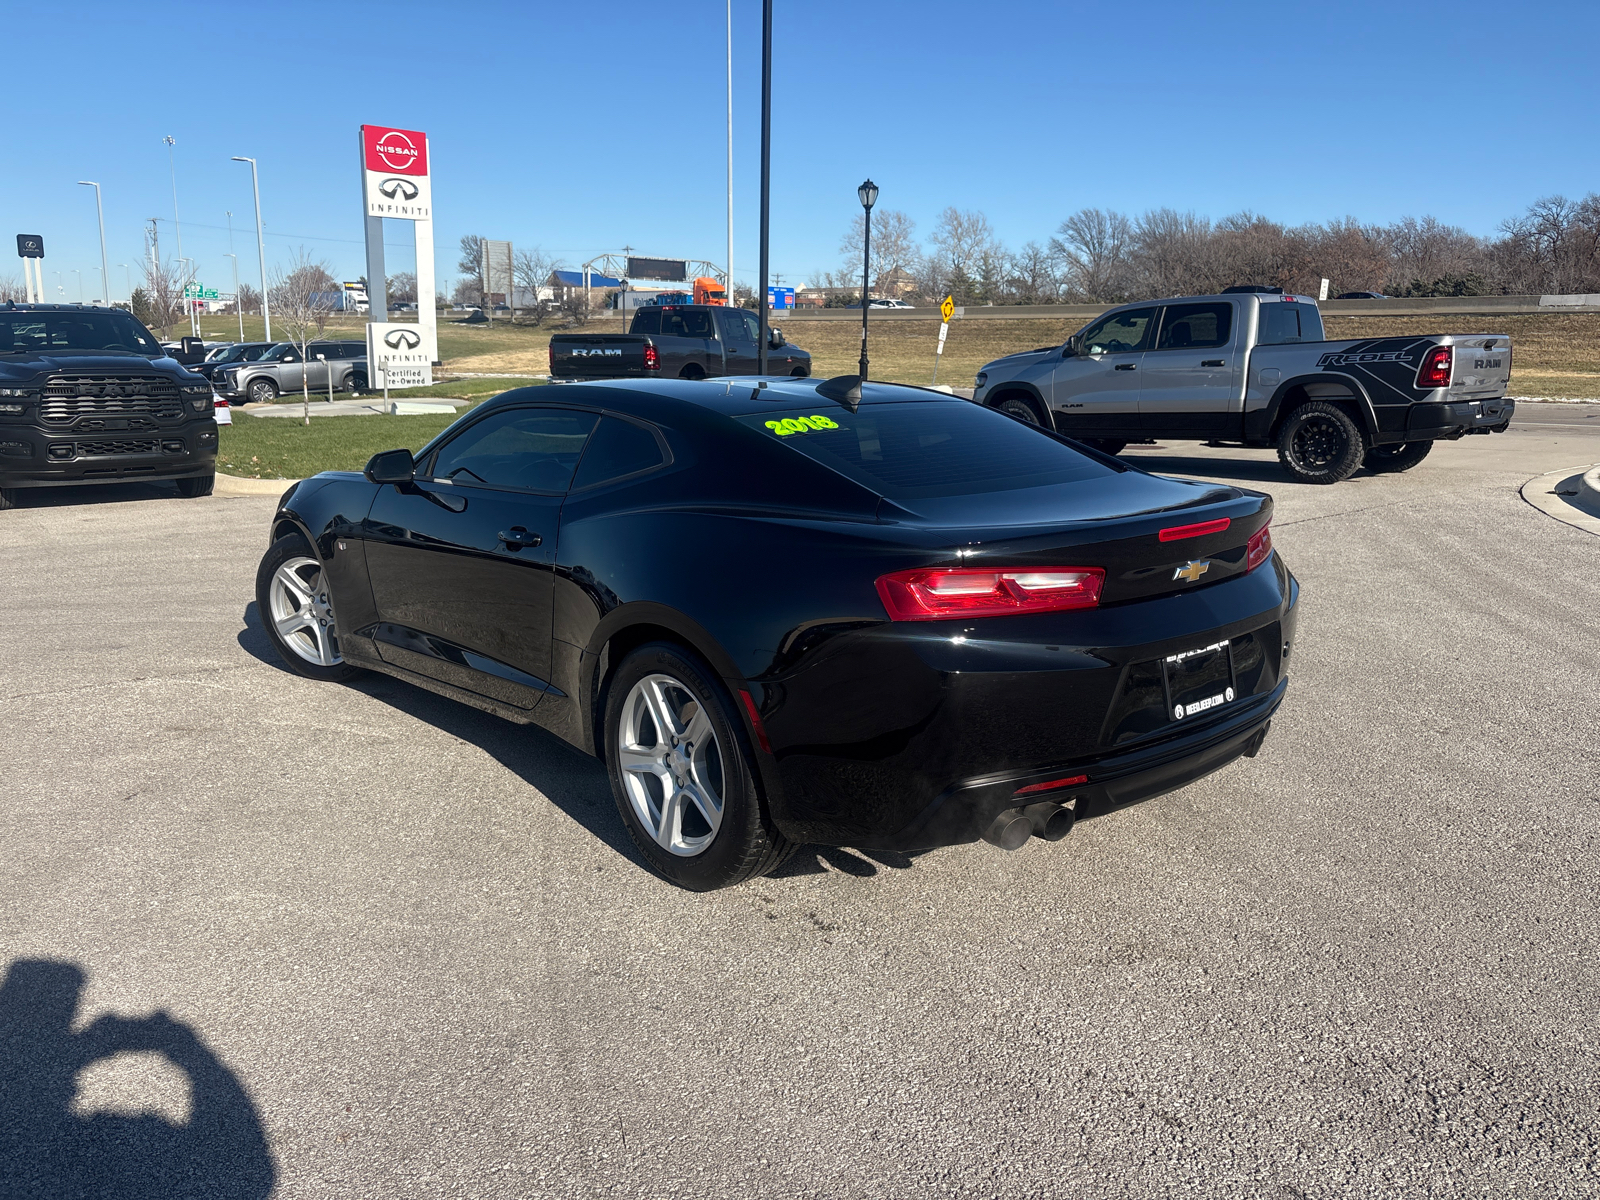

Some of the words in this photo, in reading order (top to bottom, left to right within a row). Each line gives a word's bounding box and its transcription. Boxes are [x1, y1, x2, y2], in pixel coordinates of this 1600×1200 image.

[376, 145, 418, 156] NISSAN
[371, 203, 428, 216] INFINITI
[572, 349, 622, 357] RAM
[1315, 351, 1413, 367] REBEL
[1474, 359, 1502, 369] RAM
[764, 415, 839, 436] 2018
